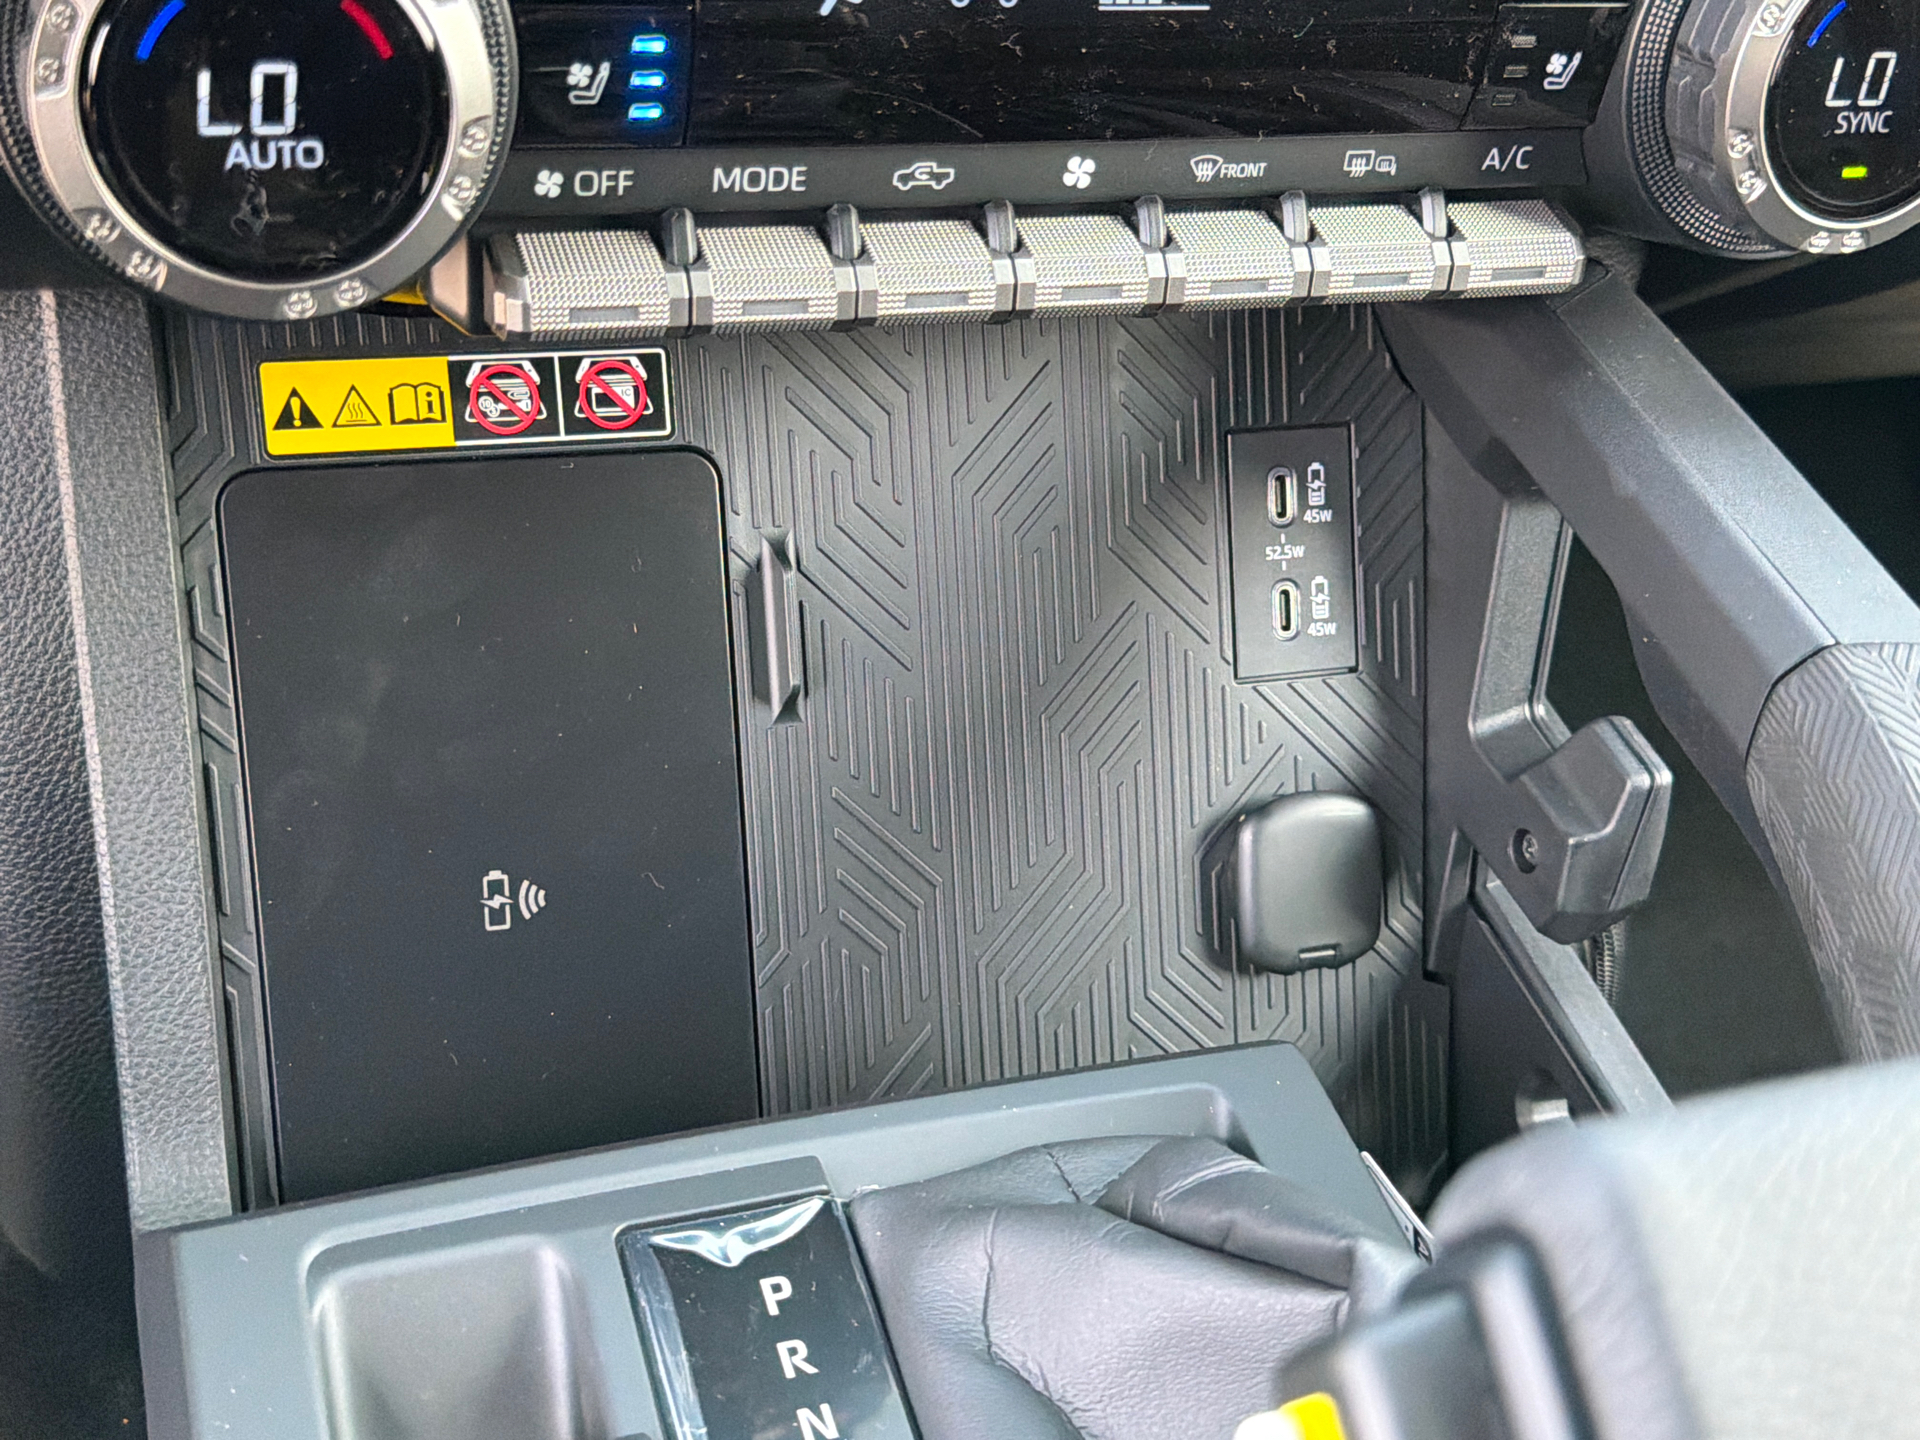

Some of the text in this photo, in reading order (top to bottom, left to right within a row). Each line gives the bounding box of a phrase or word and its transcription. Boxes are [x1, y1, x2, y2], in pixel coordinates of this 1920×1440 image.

[1825, 51, 1898, 108] LO
[196, 60, 299, 137] LO
[1834, 110, 1893, 134] SYNC
[224, 138, 325, 171] AUTO
[1481, 145, 1534, 171] A/C
[573, 169, 635, 197] OFF
[712, 165, 808, 193] MODE
[1219, 162, 1268, 179] FRONT
[621, 388, 632, 397] IC
[1303, 508, 1333, 523] 45W
[1265, 545, 1305, 561] 52.5W
[1307, 622, 1337, 637] 45W
[759, 1275, 793, 1317] P
[776, 1339, 820, 1379] R
[796, 1402, 840, 1440] N
